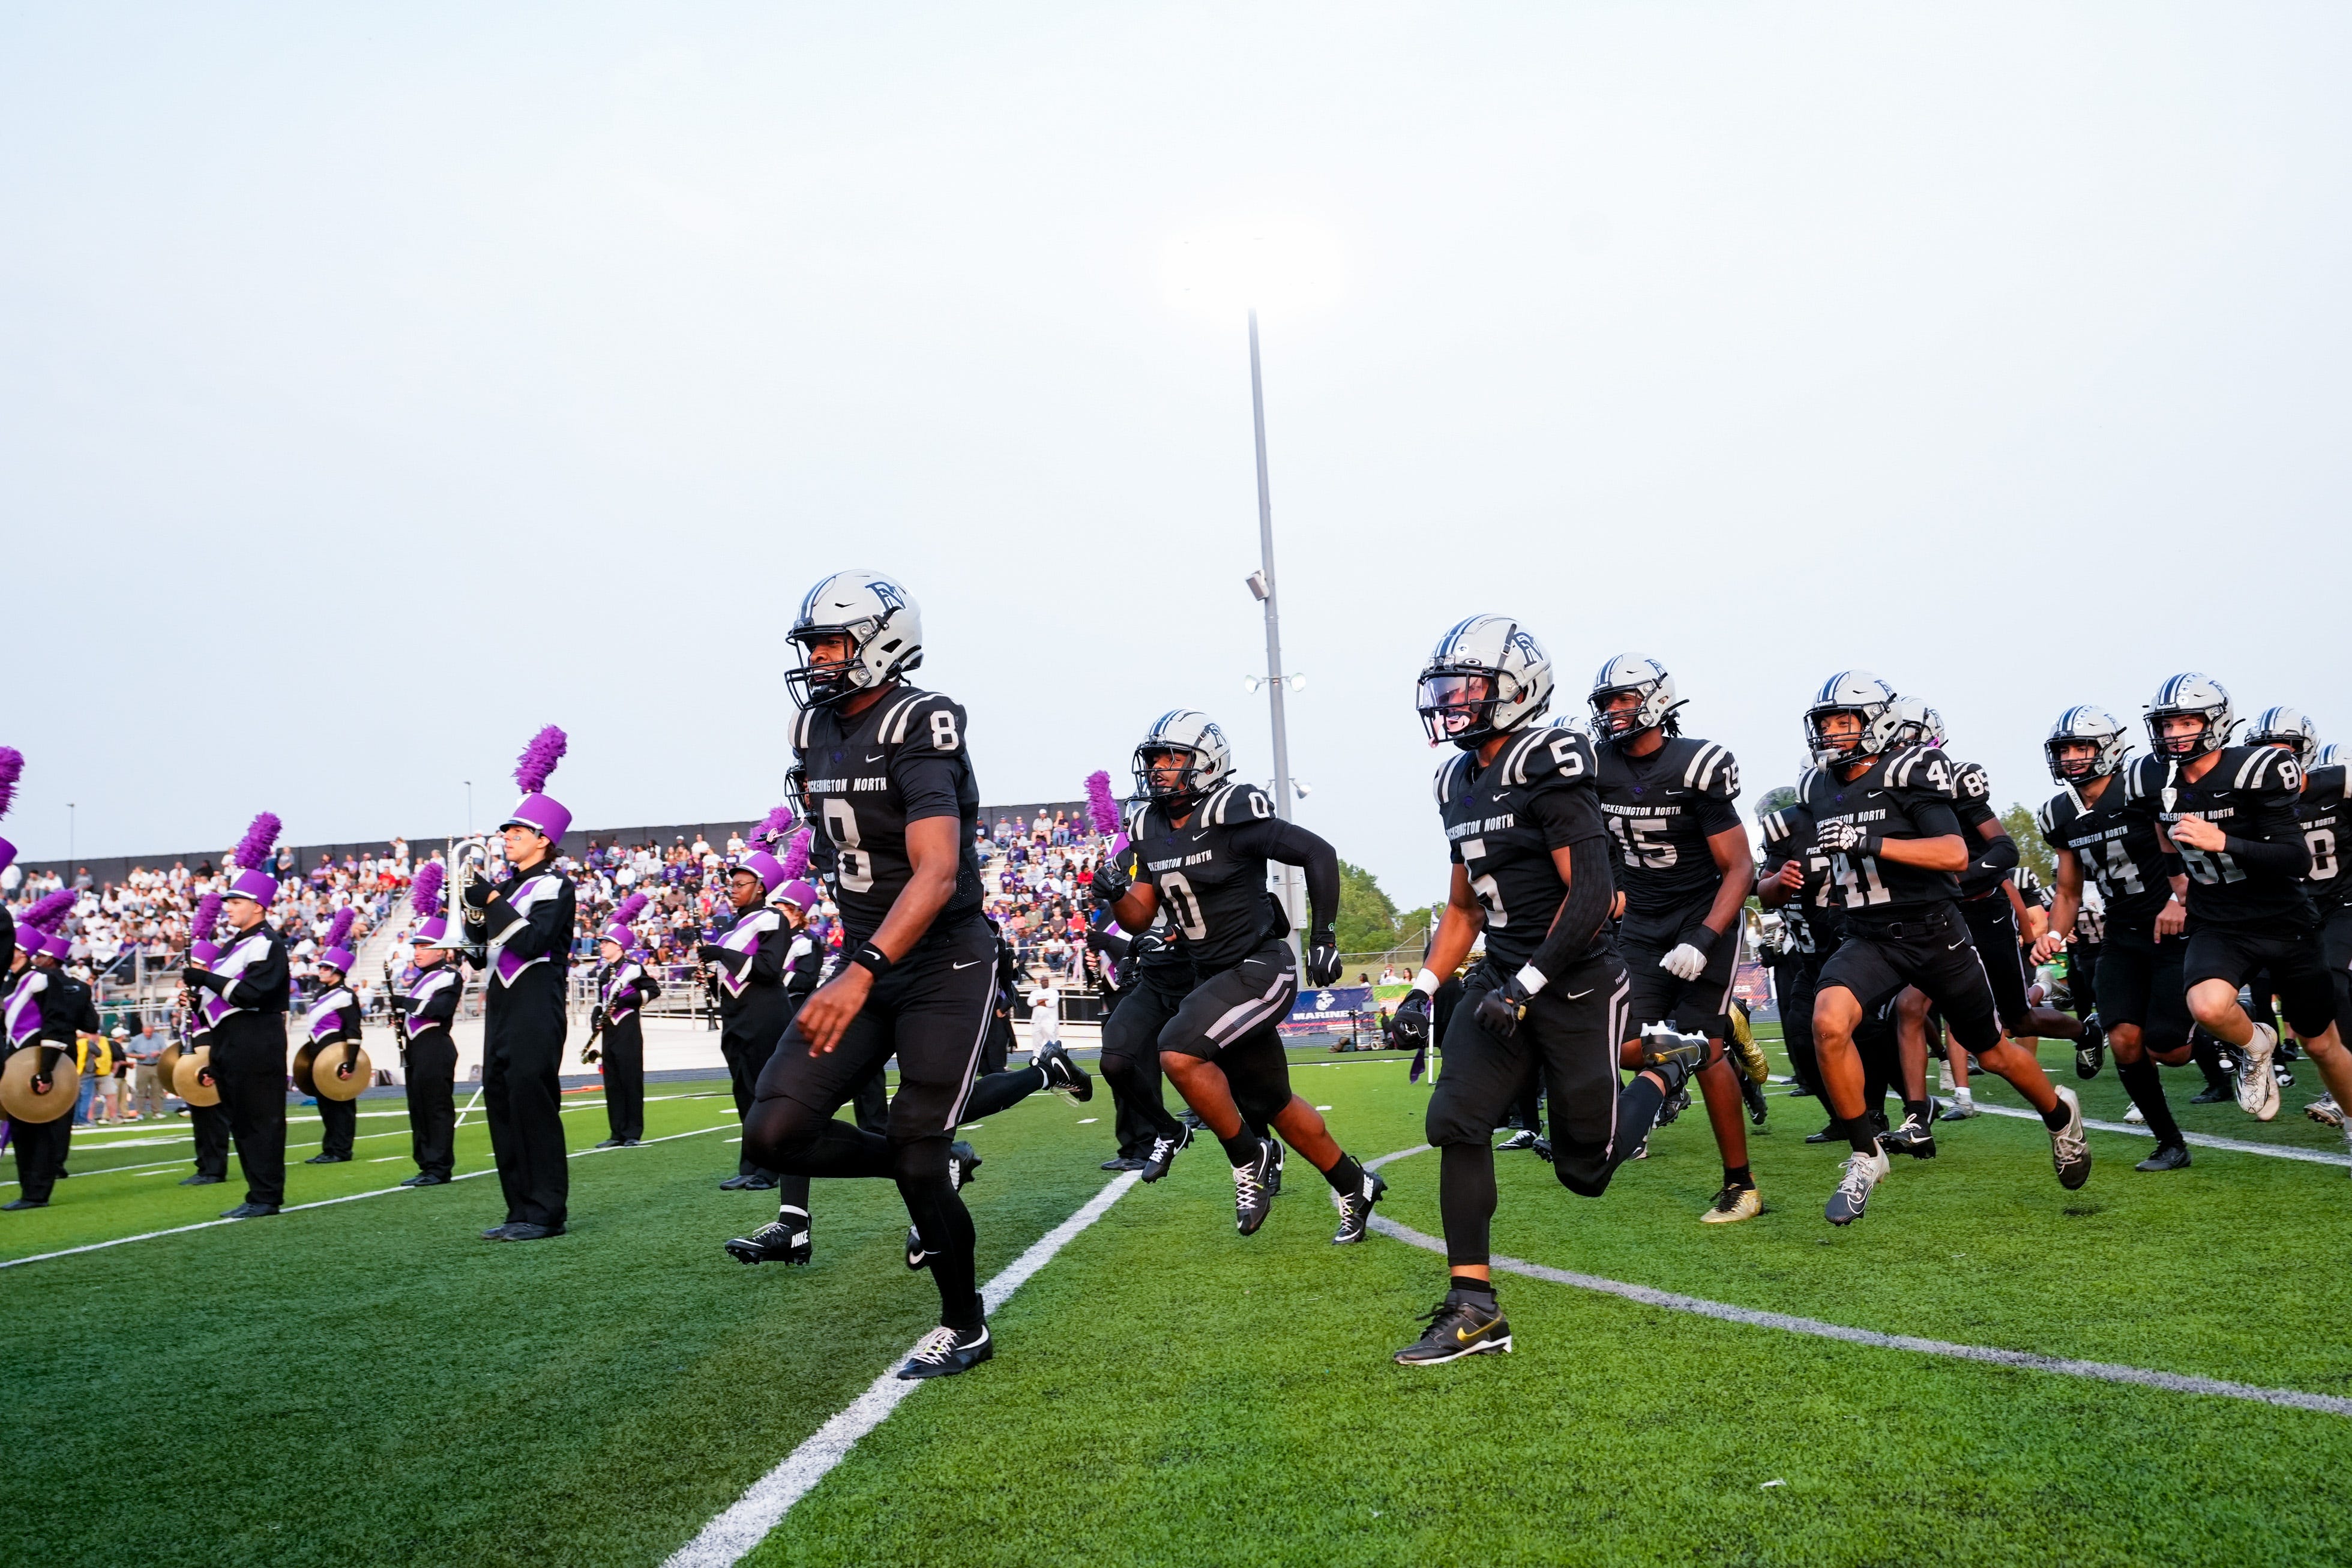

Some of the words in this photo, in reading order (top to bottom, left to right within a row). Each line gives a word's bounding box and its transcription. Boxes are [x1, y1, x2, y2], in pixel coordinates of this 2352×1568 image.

[930, 710, 959, 750] 8
[1549, 736, 1584, 776] 5
[853, 777, 887, 791] NORTH
[1722, 760, 1740, 795] 15
[1248, 792, 1270, 819] 0
[1601, 803, 1651, 816] PICKERINGTON
[1655, 806, 1681, 816] NORTH
[1858, 809, 1886, 822] NORTH
[2208, 807, 2234, 820] NORTH
[1484, 814, 1514, 832] NORTH
[2105, 825, 2128, 839] NORTH
[823, 798, 874, 893] 8
[1608, 816, 1677, 868] 15
[2299, 829, 2338, 881] 8
[1185, 850, 1212, 866] NORTH
[1460, 838, 1508, 928] 5
[1160, 871, 1207, 940] 0
[791, 1230, 808, 1248] NIKE
